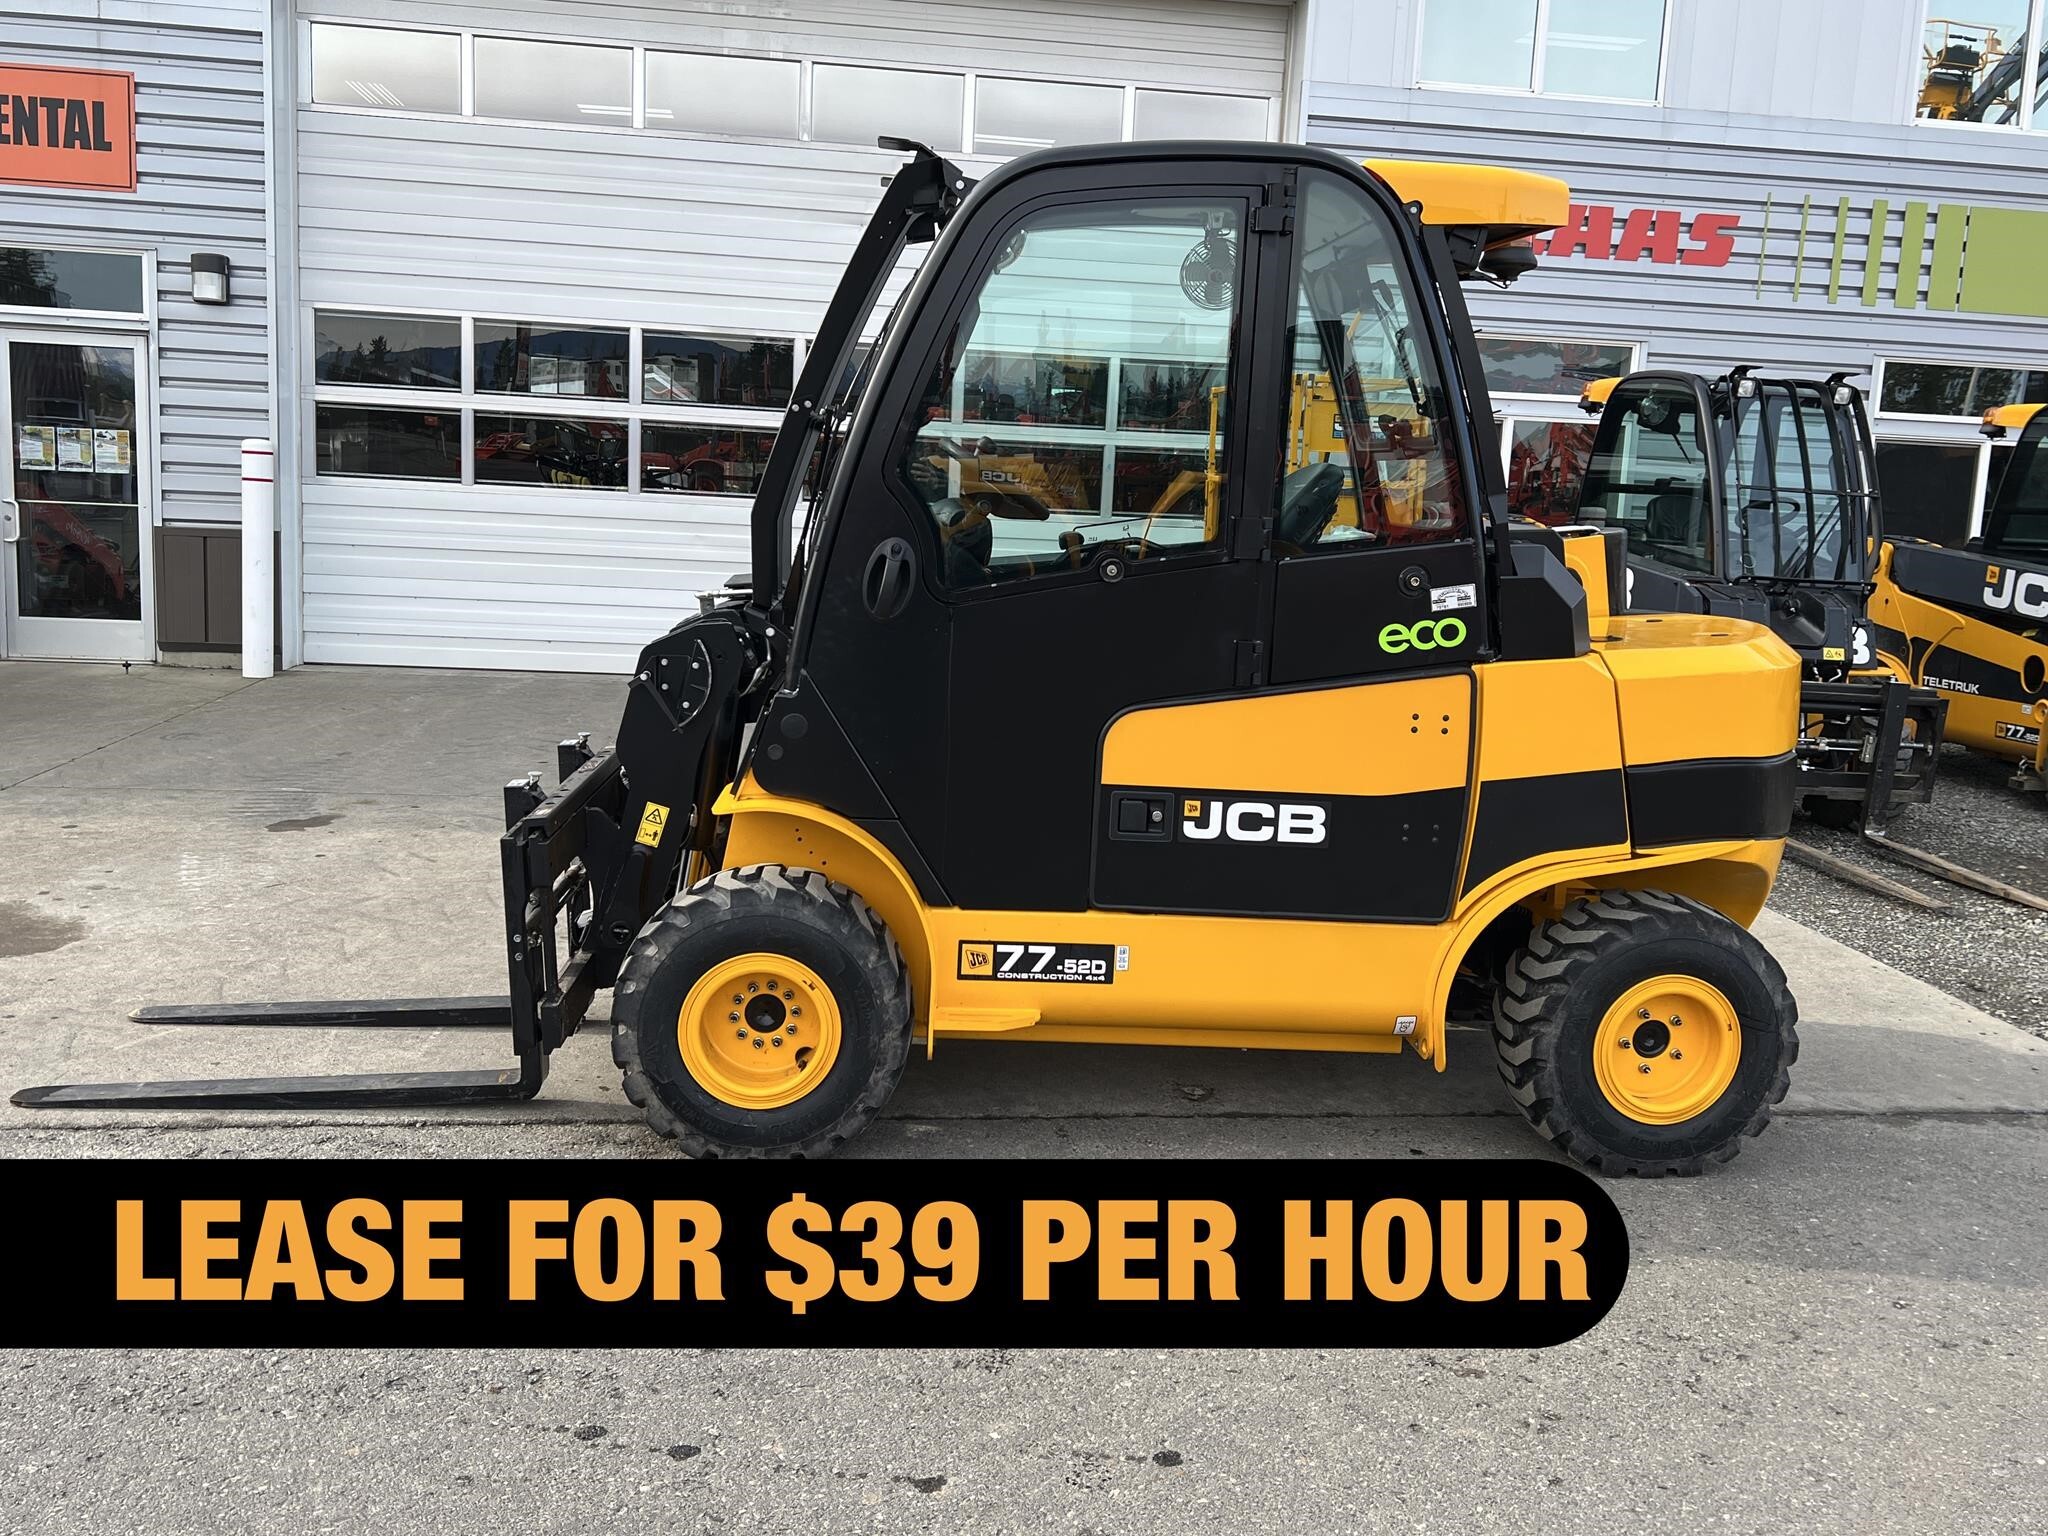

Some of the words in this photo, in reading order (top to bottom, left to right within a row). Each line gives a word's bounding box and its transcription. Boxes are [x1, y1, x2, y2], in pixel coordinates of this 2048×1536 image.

[1378, 617, 1467, 654] eco
[1923, 676, 1979, 694] TELETRUK
[1183, 801, 1327, 844] JCB
[969, 951, 988, 967] JCB
[996, 971, 1083, 981] CONSTRUCTION
[1085, 974, 1106, 982] 4x4
